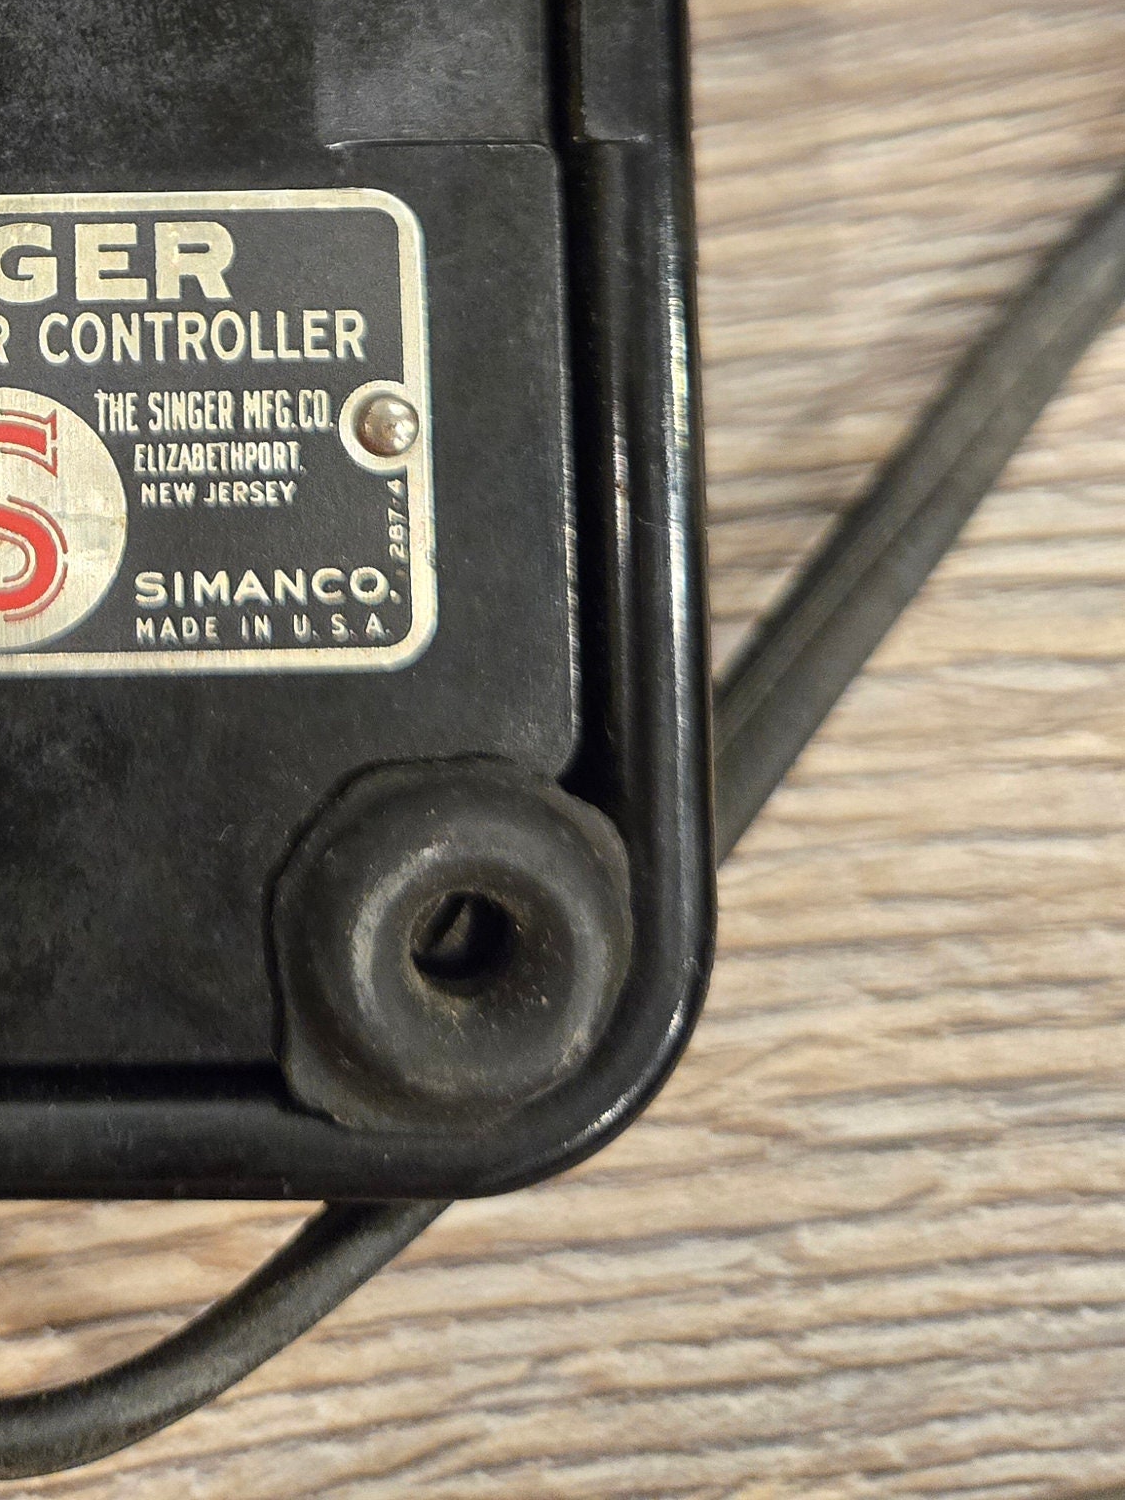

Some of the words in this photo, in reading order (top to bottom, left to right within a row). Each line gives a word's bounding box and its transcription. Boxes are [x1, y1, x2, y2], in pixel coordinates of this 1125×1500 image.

[38, 309, 367, 364] CONTROLLER
[94, 389, 139, 433] THE
[147, 390, 235, 433] SINGER
[140, 481, 197, 508] NEW
[203, 480, 298, 506] JERSEY
[135, 566, 402, 609] SIMANCO.
[135, 616, 221, 646] MADE
[240, 613, 272, 644] IN
